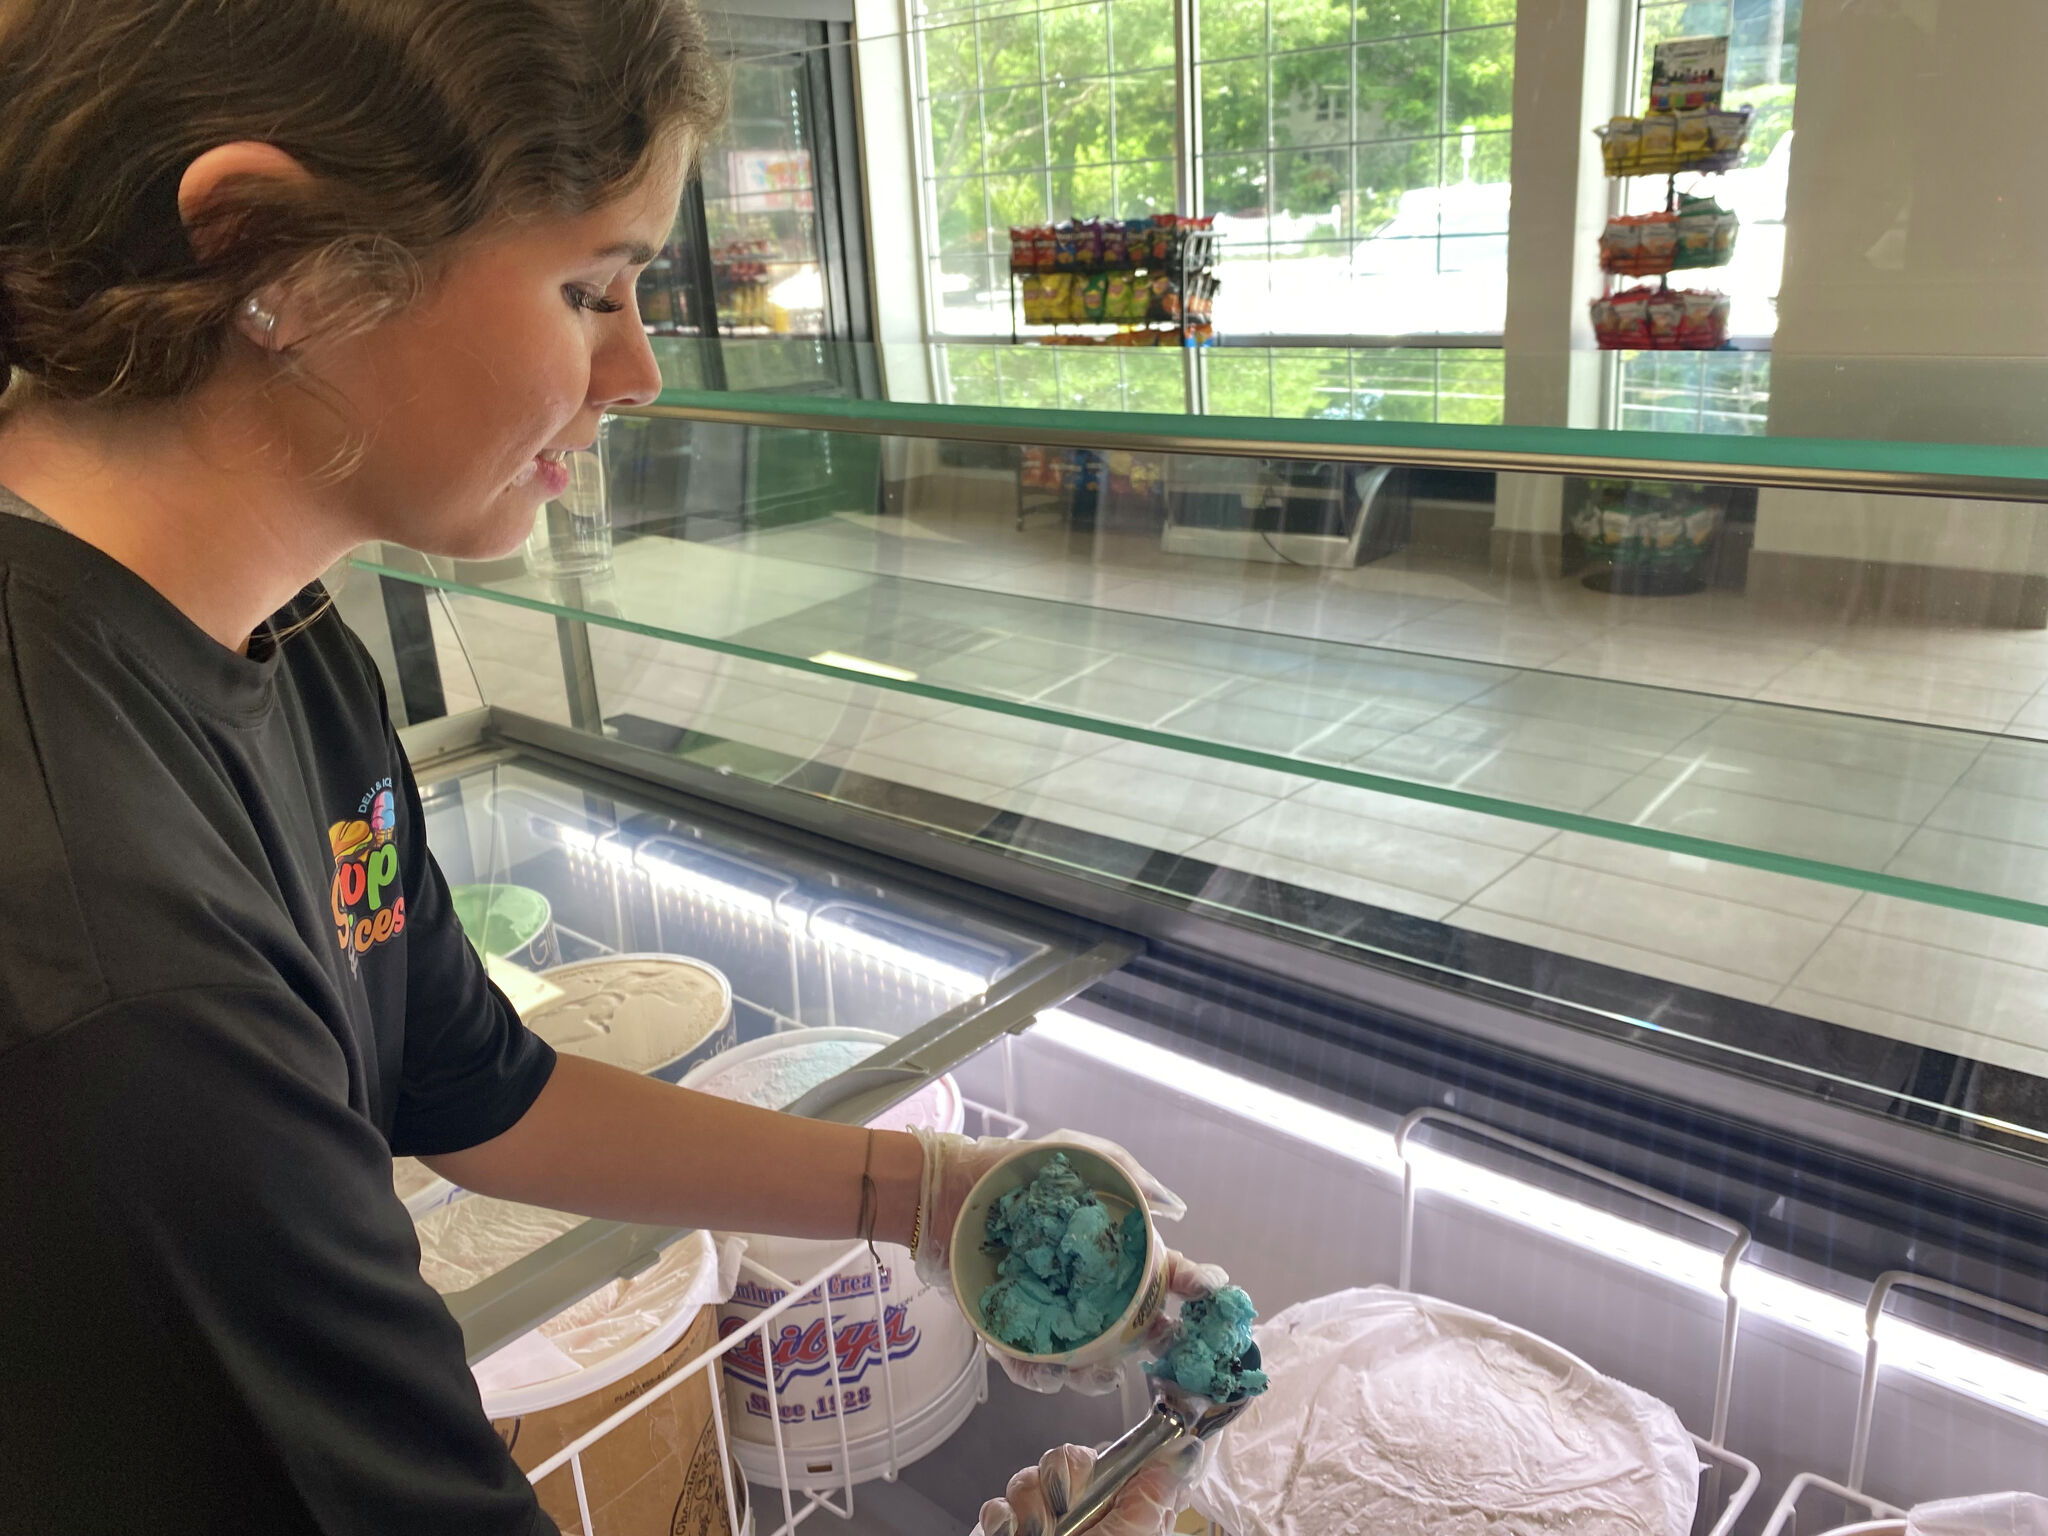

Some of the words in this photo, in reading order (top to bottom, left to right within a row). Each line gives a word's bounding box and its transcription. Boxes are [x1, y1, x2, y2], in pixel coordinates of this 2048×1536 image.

[358, 787, 376, 813] DELI
[376, 781, 382, 791] &
[749, 1391, 805, 1419] Sice
